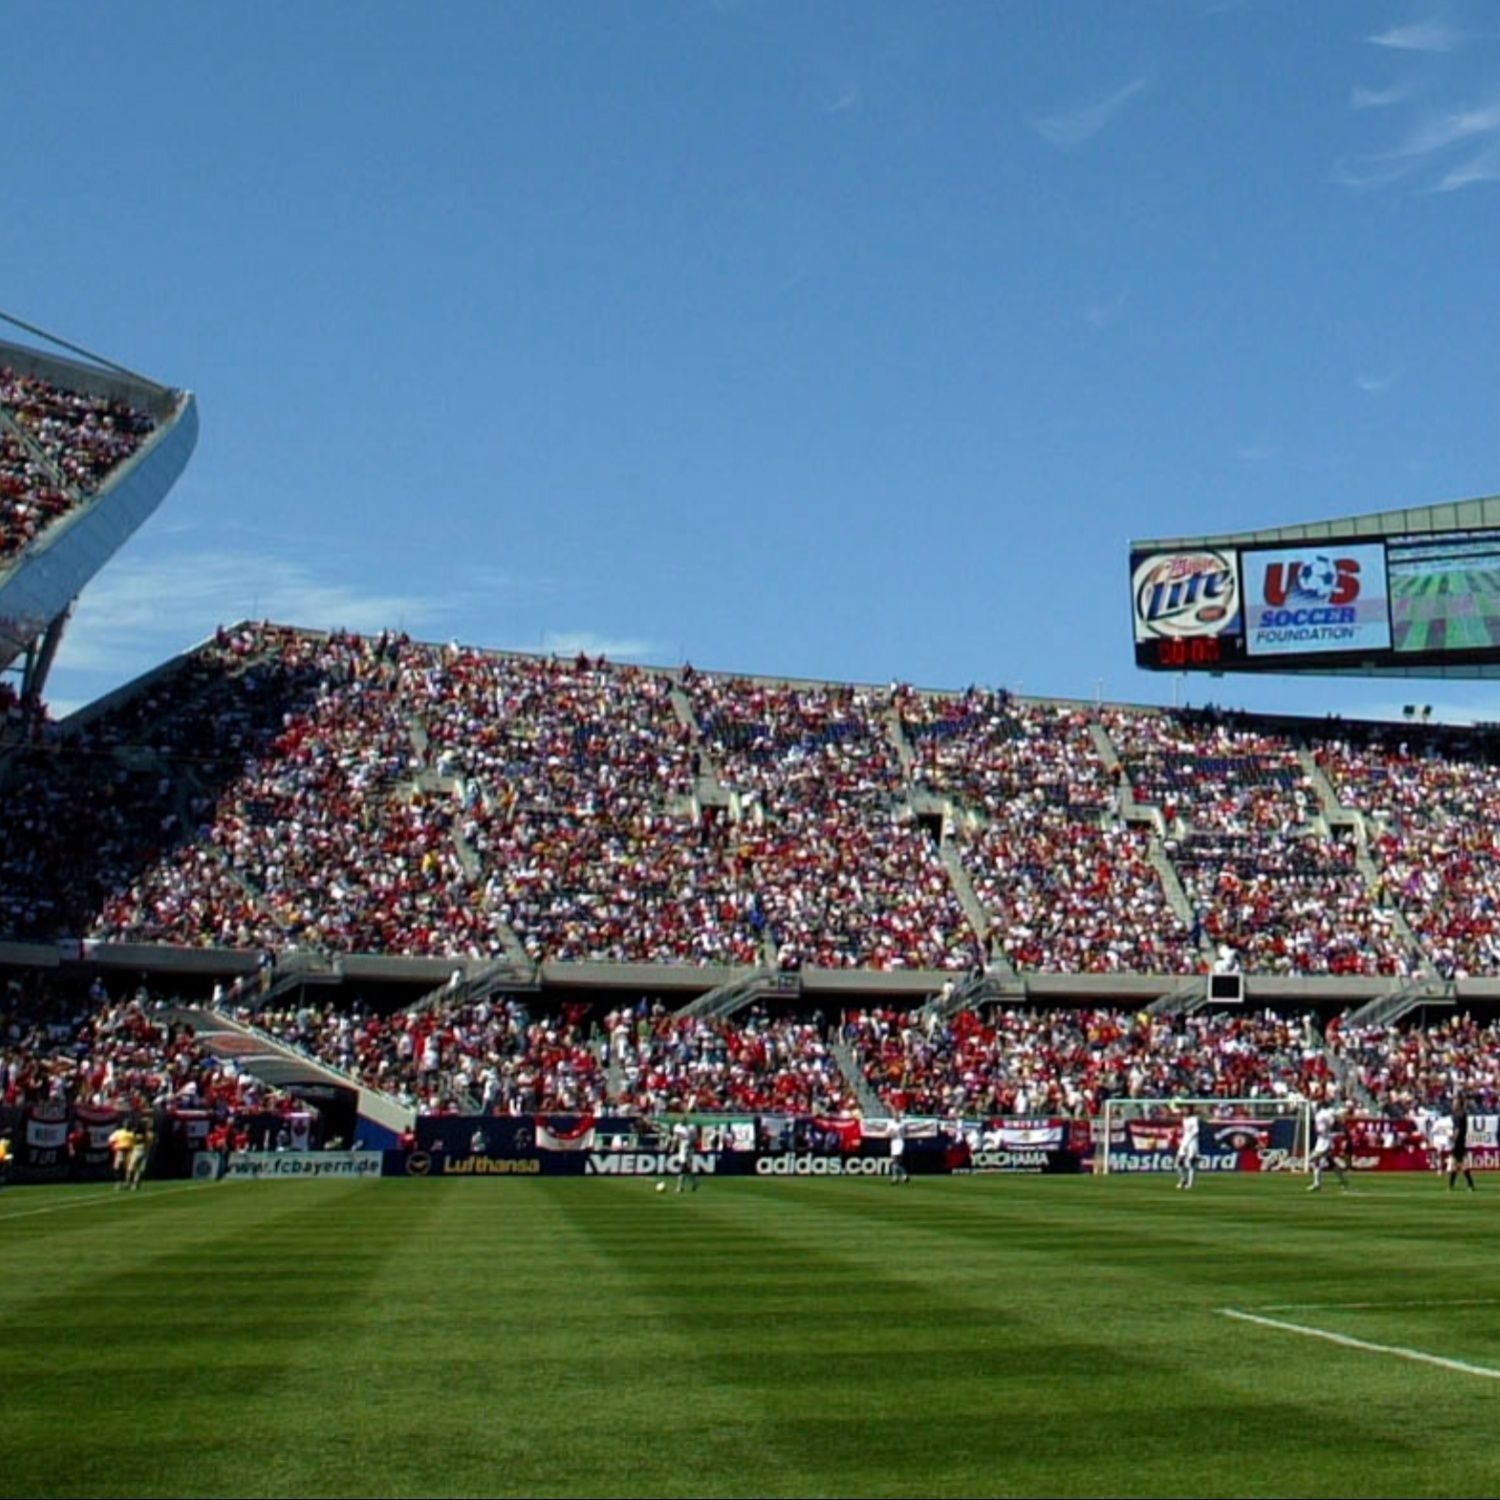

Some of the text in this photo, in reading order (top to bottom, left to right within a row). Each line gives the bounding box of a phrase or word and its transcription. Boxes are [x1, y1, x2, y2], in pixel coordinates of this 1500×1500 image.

[1259, 606, 1356, 628] SOCCER
[1256, 627, 1354, 644] FOUNDATION
[229, 1158, 378, 1176] www.fcbayern.de
[443, 1154, 540, 1173] Lufthansa
[970, 1152, 1049, 1168] YOKOHAMA
[1109, 1152, 1238, 1170] Masteard
